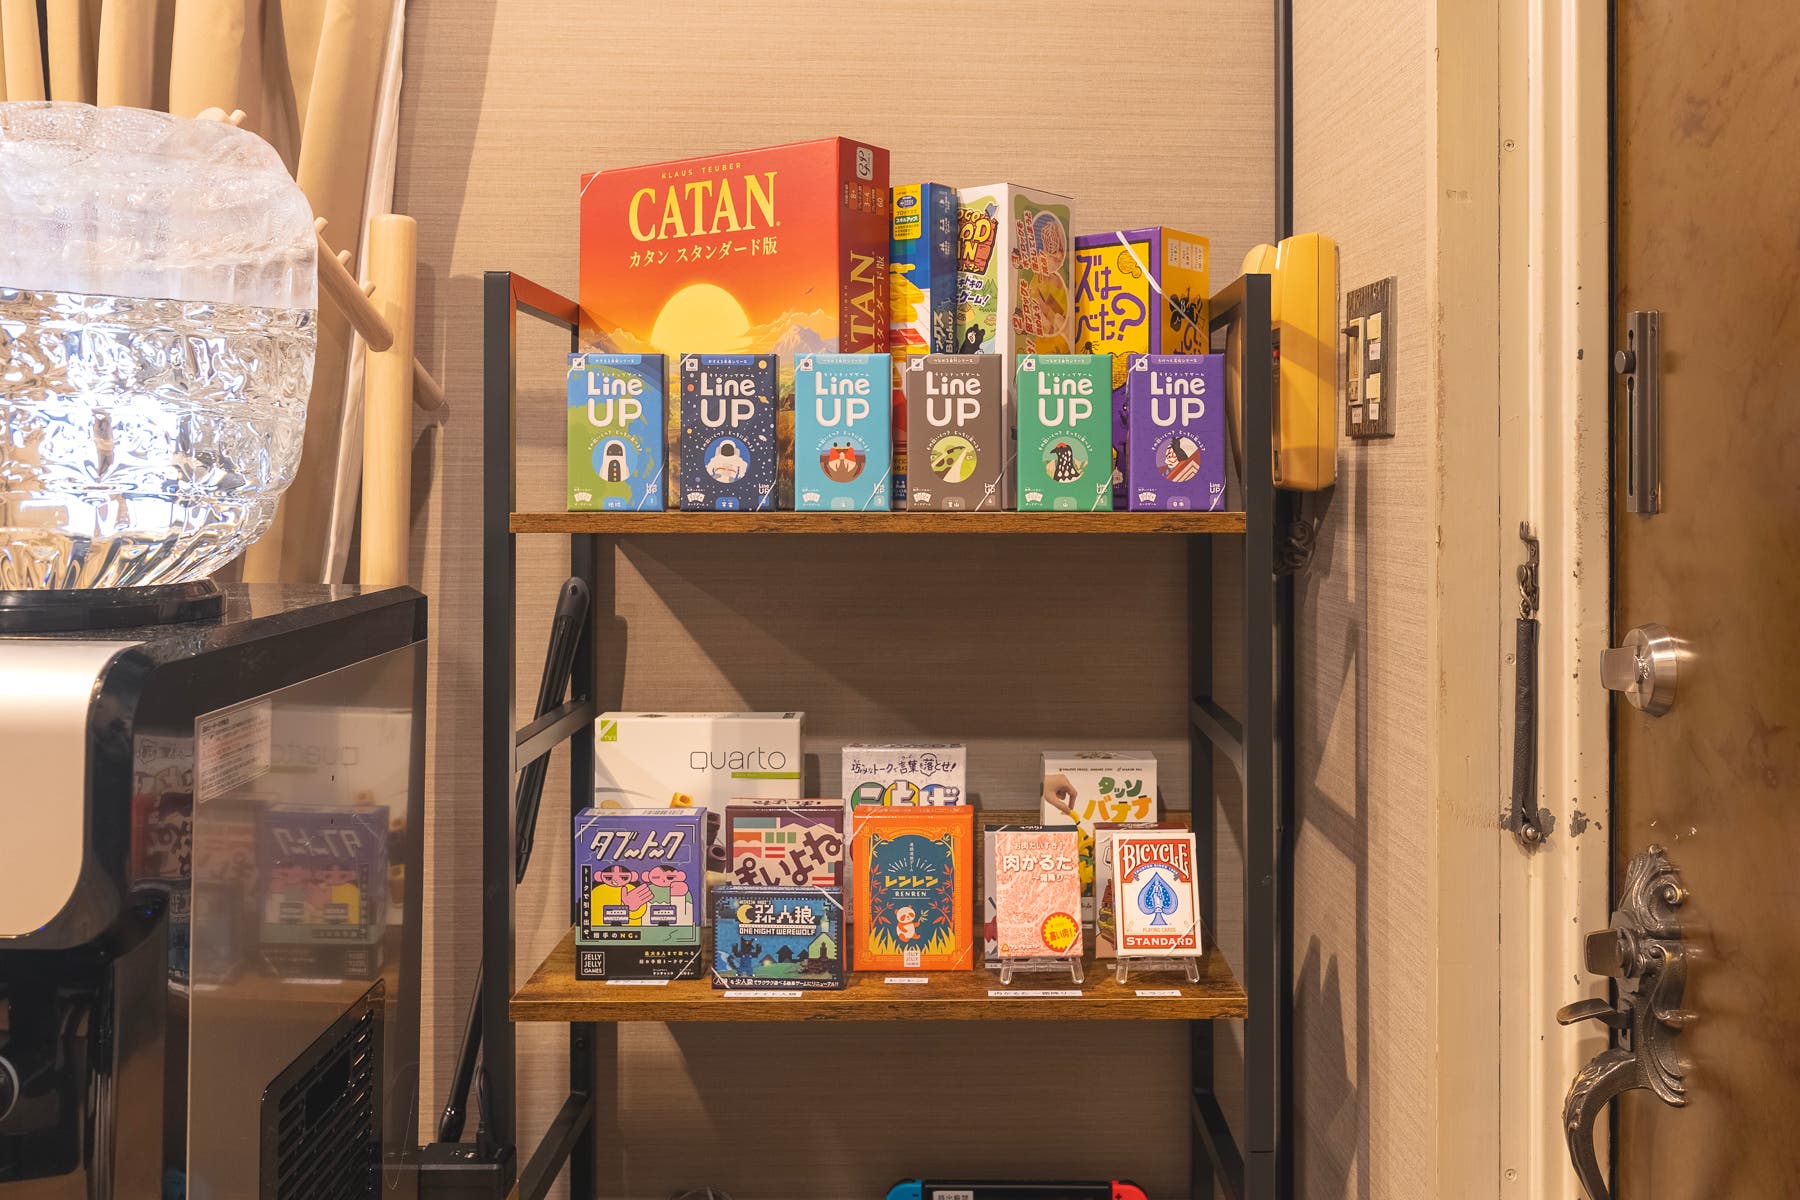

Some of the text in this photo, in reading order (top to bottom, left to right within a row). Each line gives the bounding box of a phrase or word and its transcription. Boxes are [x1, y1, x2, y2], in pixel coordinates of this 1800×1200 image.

[661, 162, 742, 180] KLAUS TEUBER
[628, 171, 779, 243] CATAN
[629, 236, 779, 269] カタン スタンダード版
[957, 276, 983, 289] キドキの
[850, 249, 875, 353] TAN
[588, 371, 643, 396] Line
[701, 372, 756, 396] Line
[816, 371, 870, 395] Line
[926, 371, 981, 395] Line
[1038, 371, 1093, 395] Line
[1151, 371, 1205, 395] Line
[587, 398, 642, 428] UP
[701, 398, 755, 428] UP
[816, 398, 869, 427] UP
[926, 397, 980, 427] UP
[1038, 397, 1093, 427] UP
[1151, 397, 1205, 427] UP
[689, 747, 786, 773] quarto
[1098, 776, 1142, 798] タッソ
[1083, 795, 1152, 823] バナナ
[1003, 854, 1074, 873] 肉かるた
[1123, 844, 1190, 880] BICYCLE
[885, 876, 939, 888] レンレン
[776, 928, 815, 936] WEREWOLF
[1126, 937, 1193, 946] STANDARD
